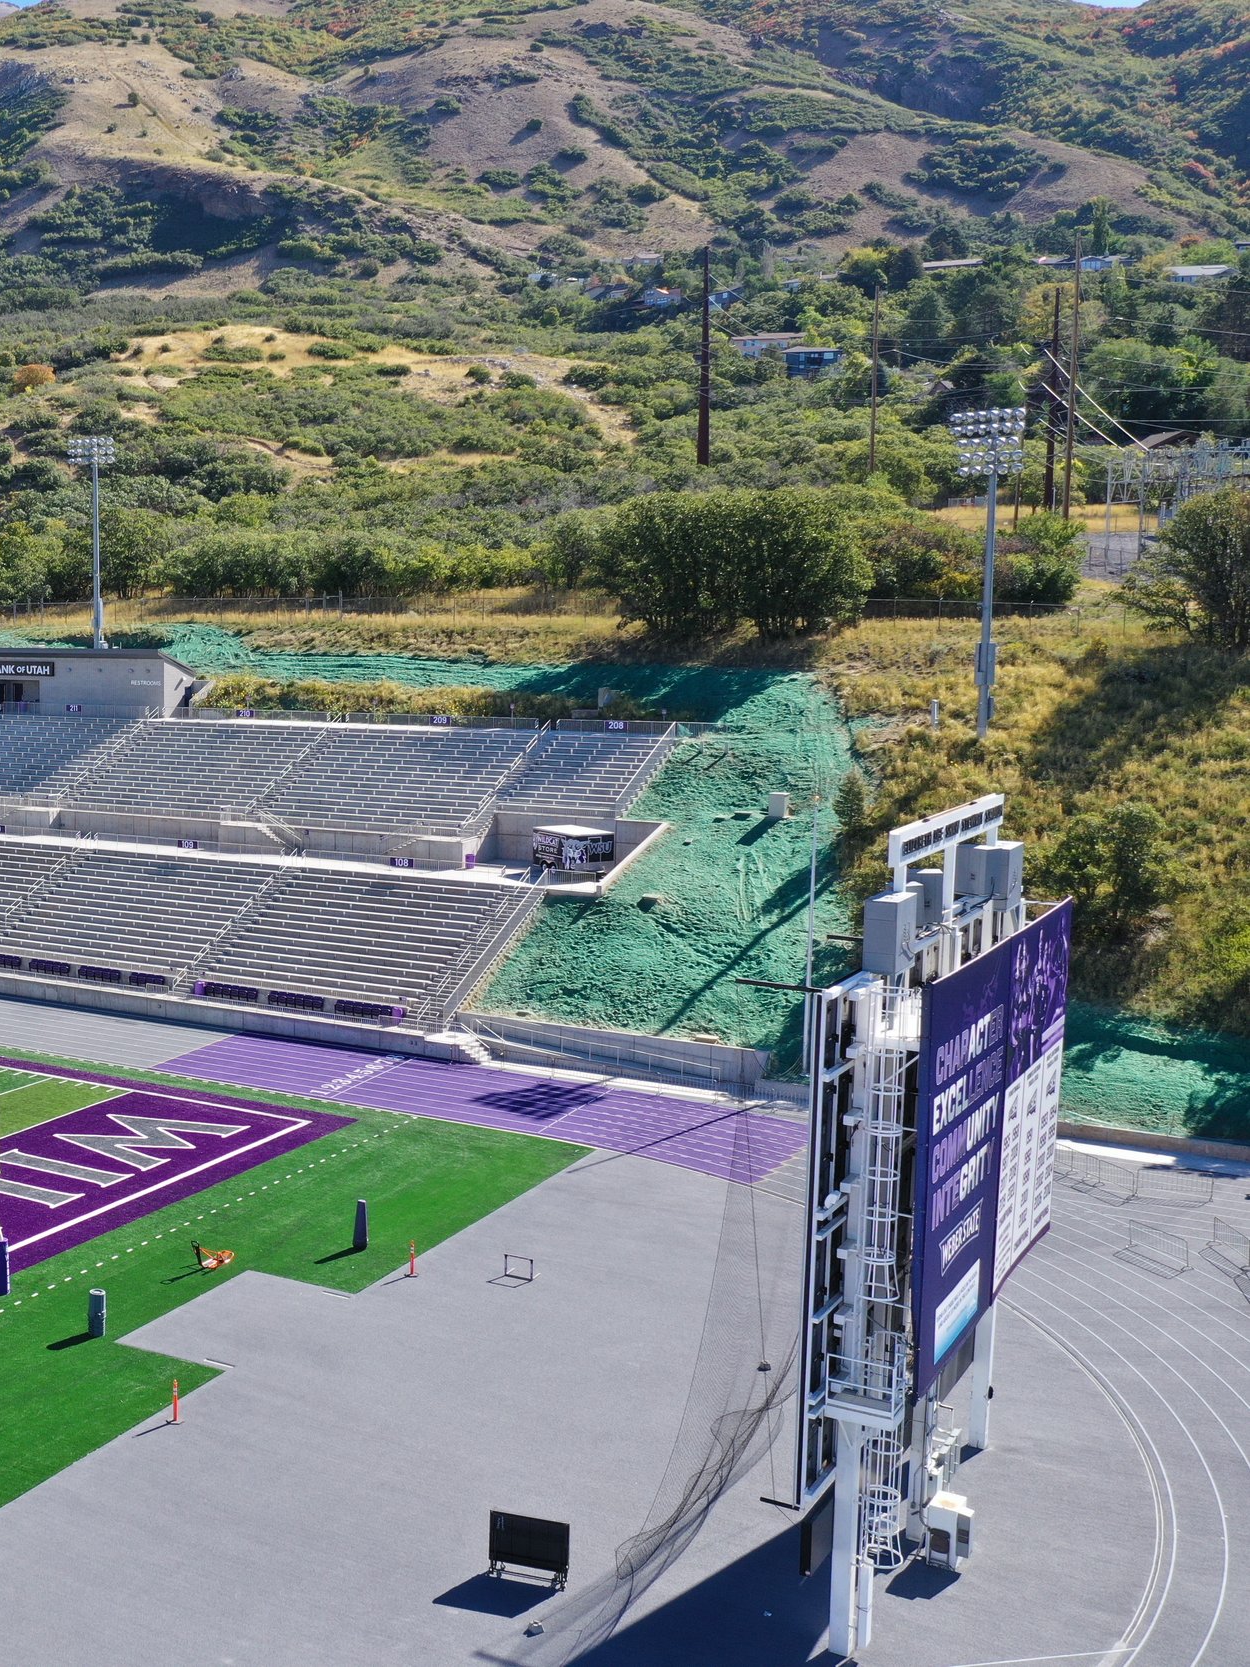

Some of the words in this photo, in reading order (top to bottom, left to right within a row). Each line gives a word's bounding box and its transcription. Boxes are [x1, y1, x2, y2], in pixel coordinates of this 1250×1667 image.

[26, 666, 50, 675] UTAH
[433, 716, 447, 724] 209
[181, 840, 194, 848] 109
[538, 844, 558, 854] STORE
[588, 840, 612, 856] WSU
[395, 858, 409, 867] 108
[935, 1004, 1004, 1086] CHARACTER
[932, 1046, 1004, 1137] EXCELLENCE
[932, 1092, 1000, 1185] COMMUNITY
[931, 1136, 995, 1232] INTEGRITY
[942, 1226, 962, 1268] WEBER
[962, 1207, 980, 1242] STATE
